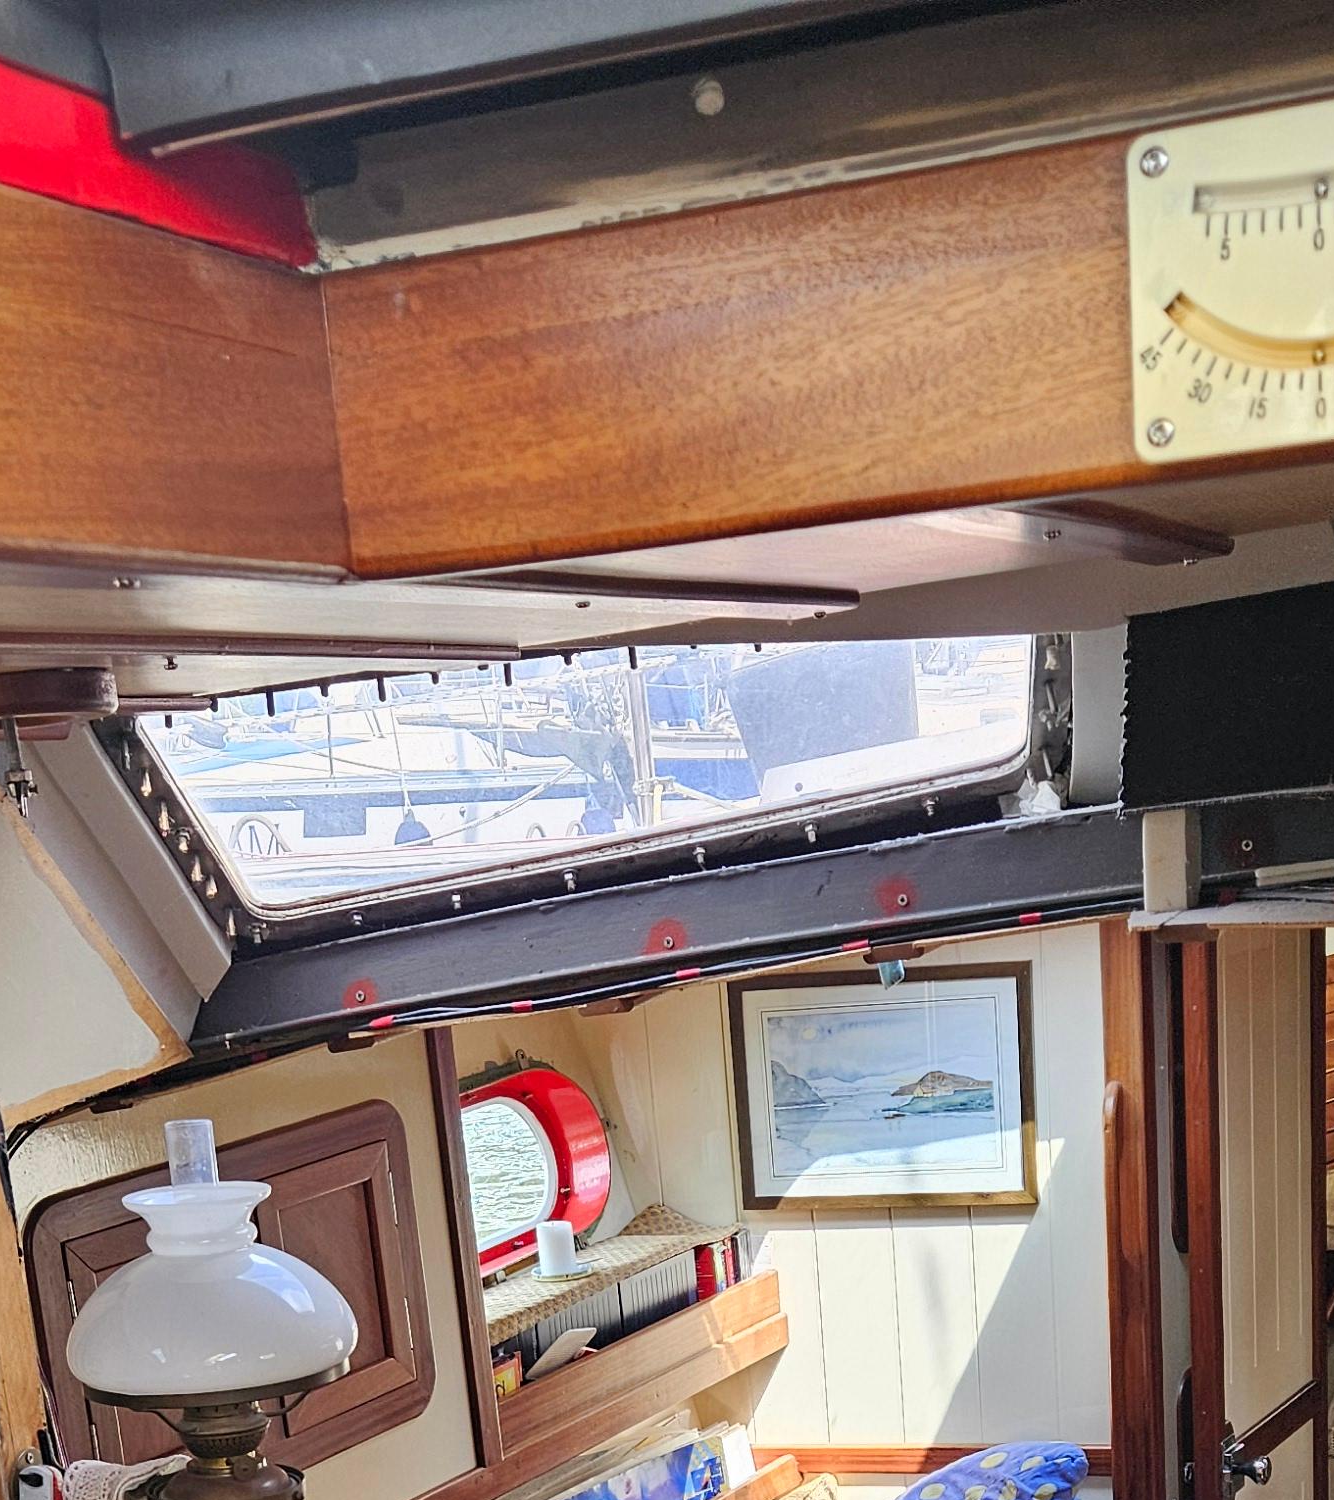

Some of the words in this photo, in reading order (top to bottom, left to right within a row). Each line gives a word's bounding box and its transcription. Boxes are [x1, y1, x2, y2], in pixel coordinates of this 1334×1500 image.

[1220, 237, 1231, 261] 5
[1313, 228, 1325, 251] 0
[1139, 345, 1163, 372] 45
[1187, 378, 1212, 404] 30
[1248, 398, 1268, 420] 15
[1315, 398, 1327, 420] 0
